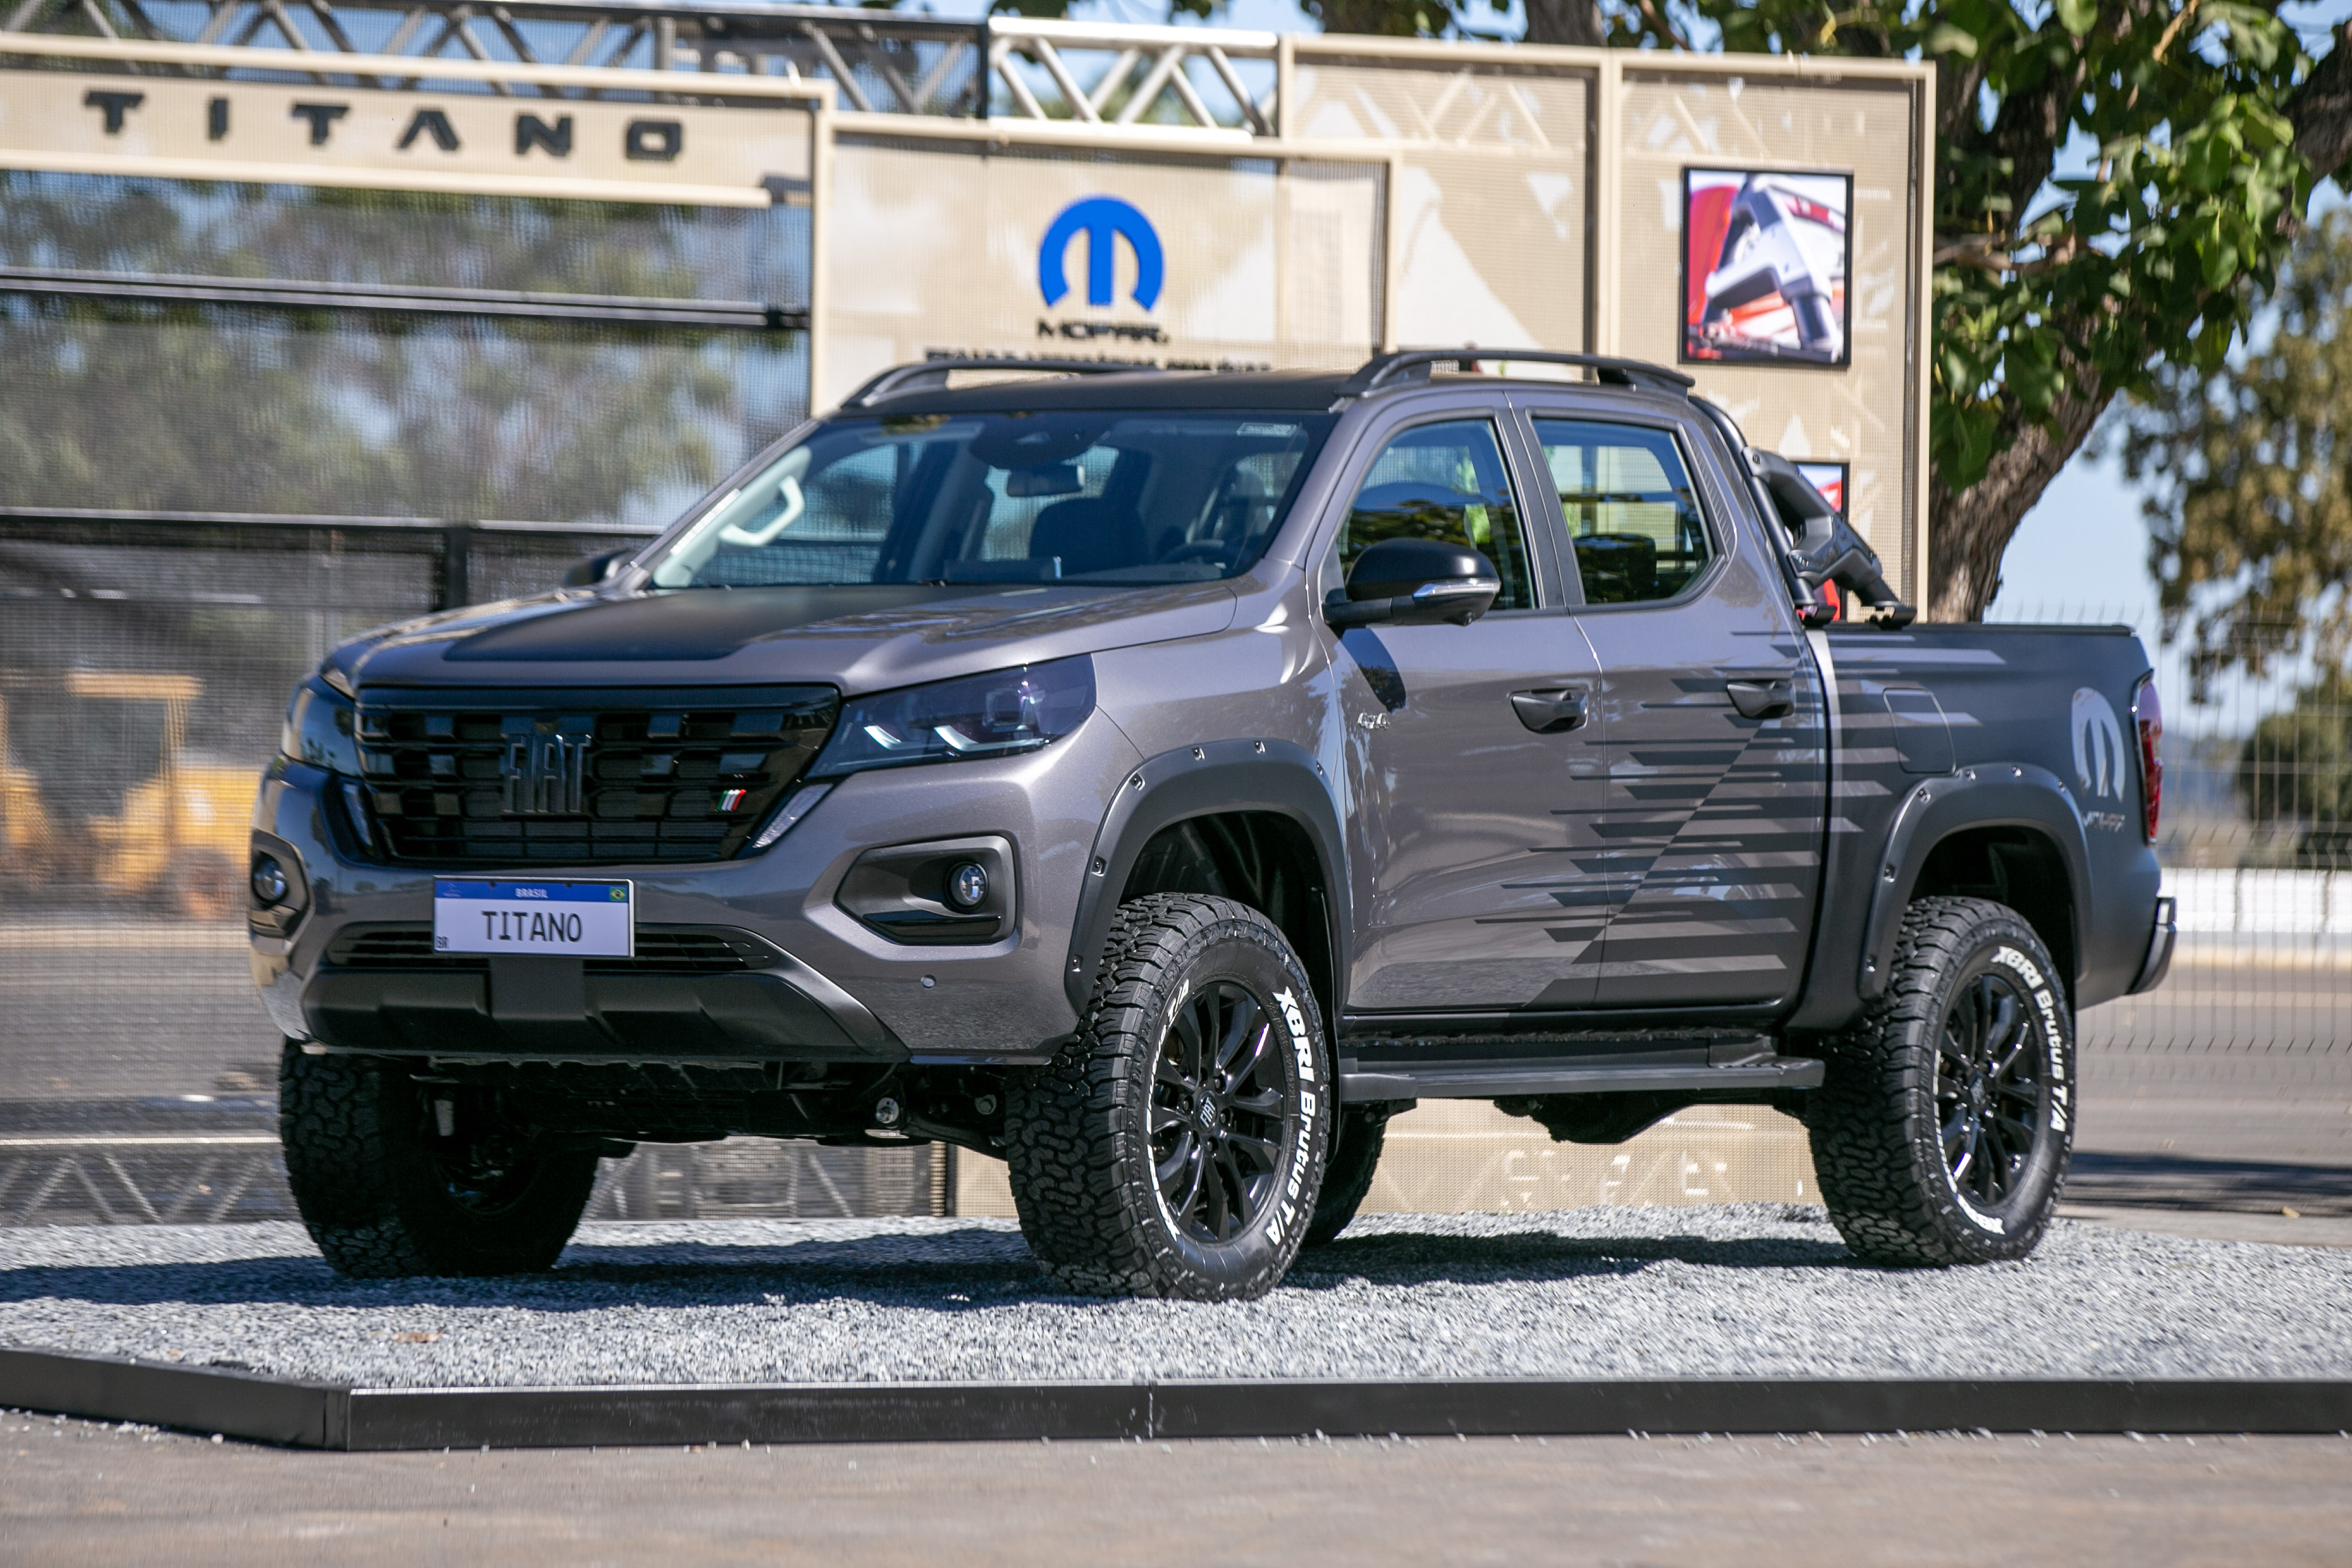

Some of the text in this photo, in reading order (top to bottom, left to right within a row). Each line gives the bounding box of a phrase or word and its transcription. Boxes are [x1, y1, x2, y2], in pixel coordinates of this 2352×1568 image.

[83, 89, 684, 161] TITANO
[502, 734, 591, 814] FIAT
[515, 887, 548, 899] BRASIL
[436, 935, 449, 950] BR
[481, 910, 582, 943] TITANO
[1991, 946, 2069, 1132] XBRI Brutus T/A
[1200, 1096, 1216, 1128] FIAT
[1265, 986, 1316, 1246] XBRI Brutus T/A
